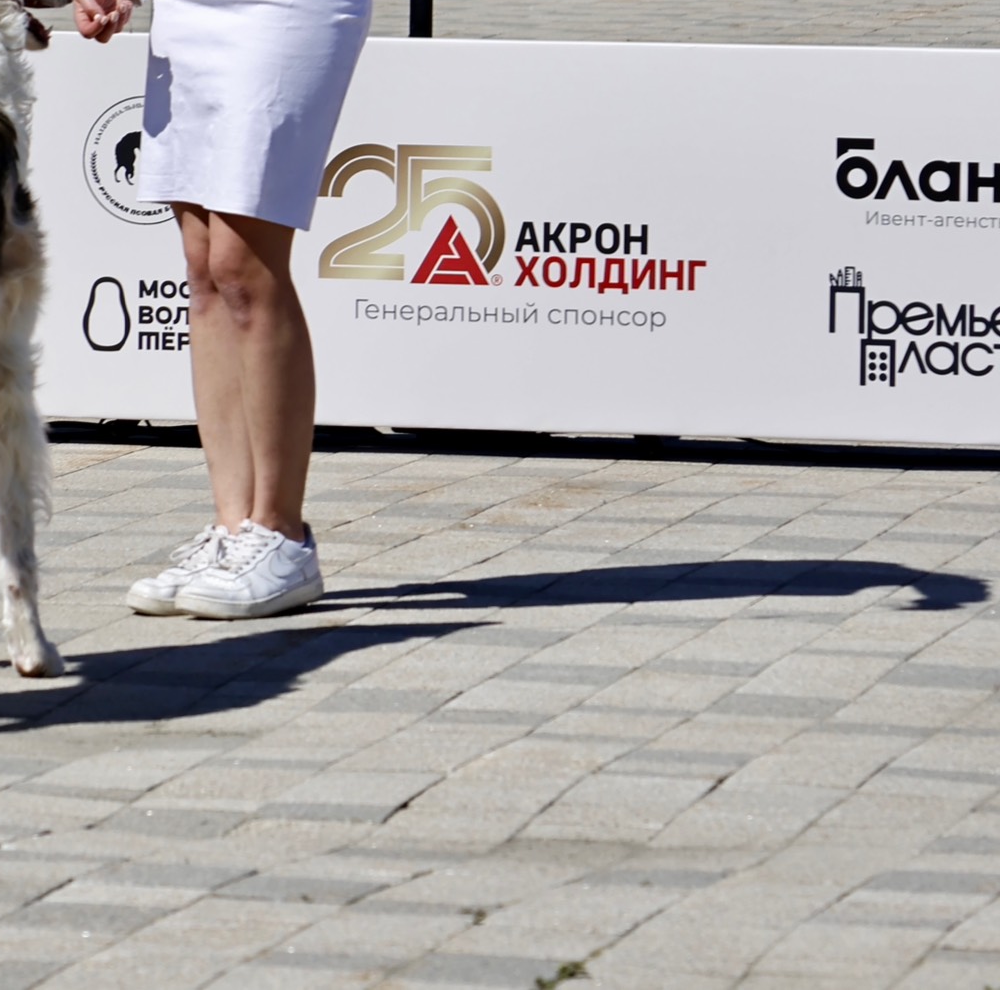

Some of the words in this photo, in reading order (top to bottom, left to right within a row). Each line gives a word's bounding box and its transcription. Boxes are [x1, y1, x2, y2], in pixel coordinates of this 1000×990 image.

[865, 210, 1000, 229] Ивент-агенст
[515, 221, 649, 255] АКРОН
[514, 255, 707, 295] ХОЛДИНГ
[355, 298, 538, 326] Генеральный
[547, 308, 668, 333] спонсор
